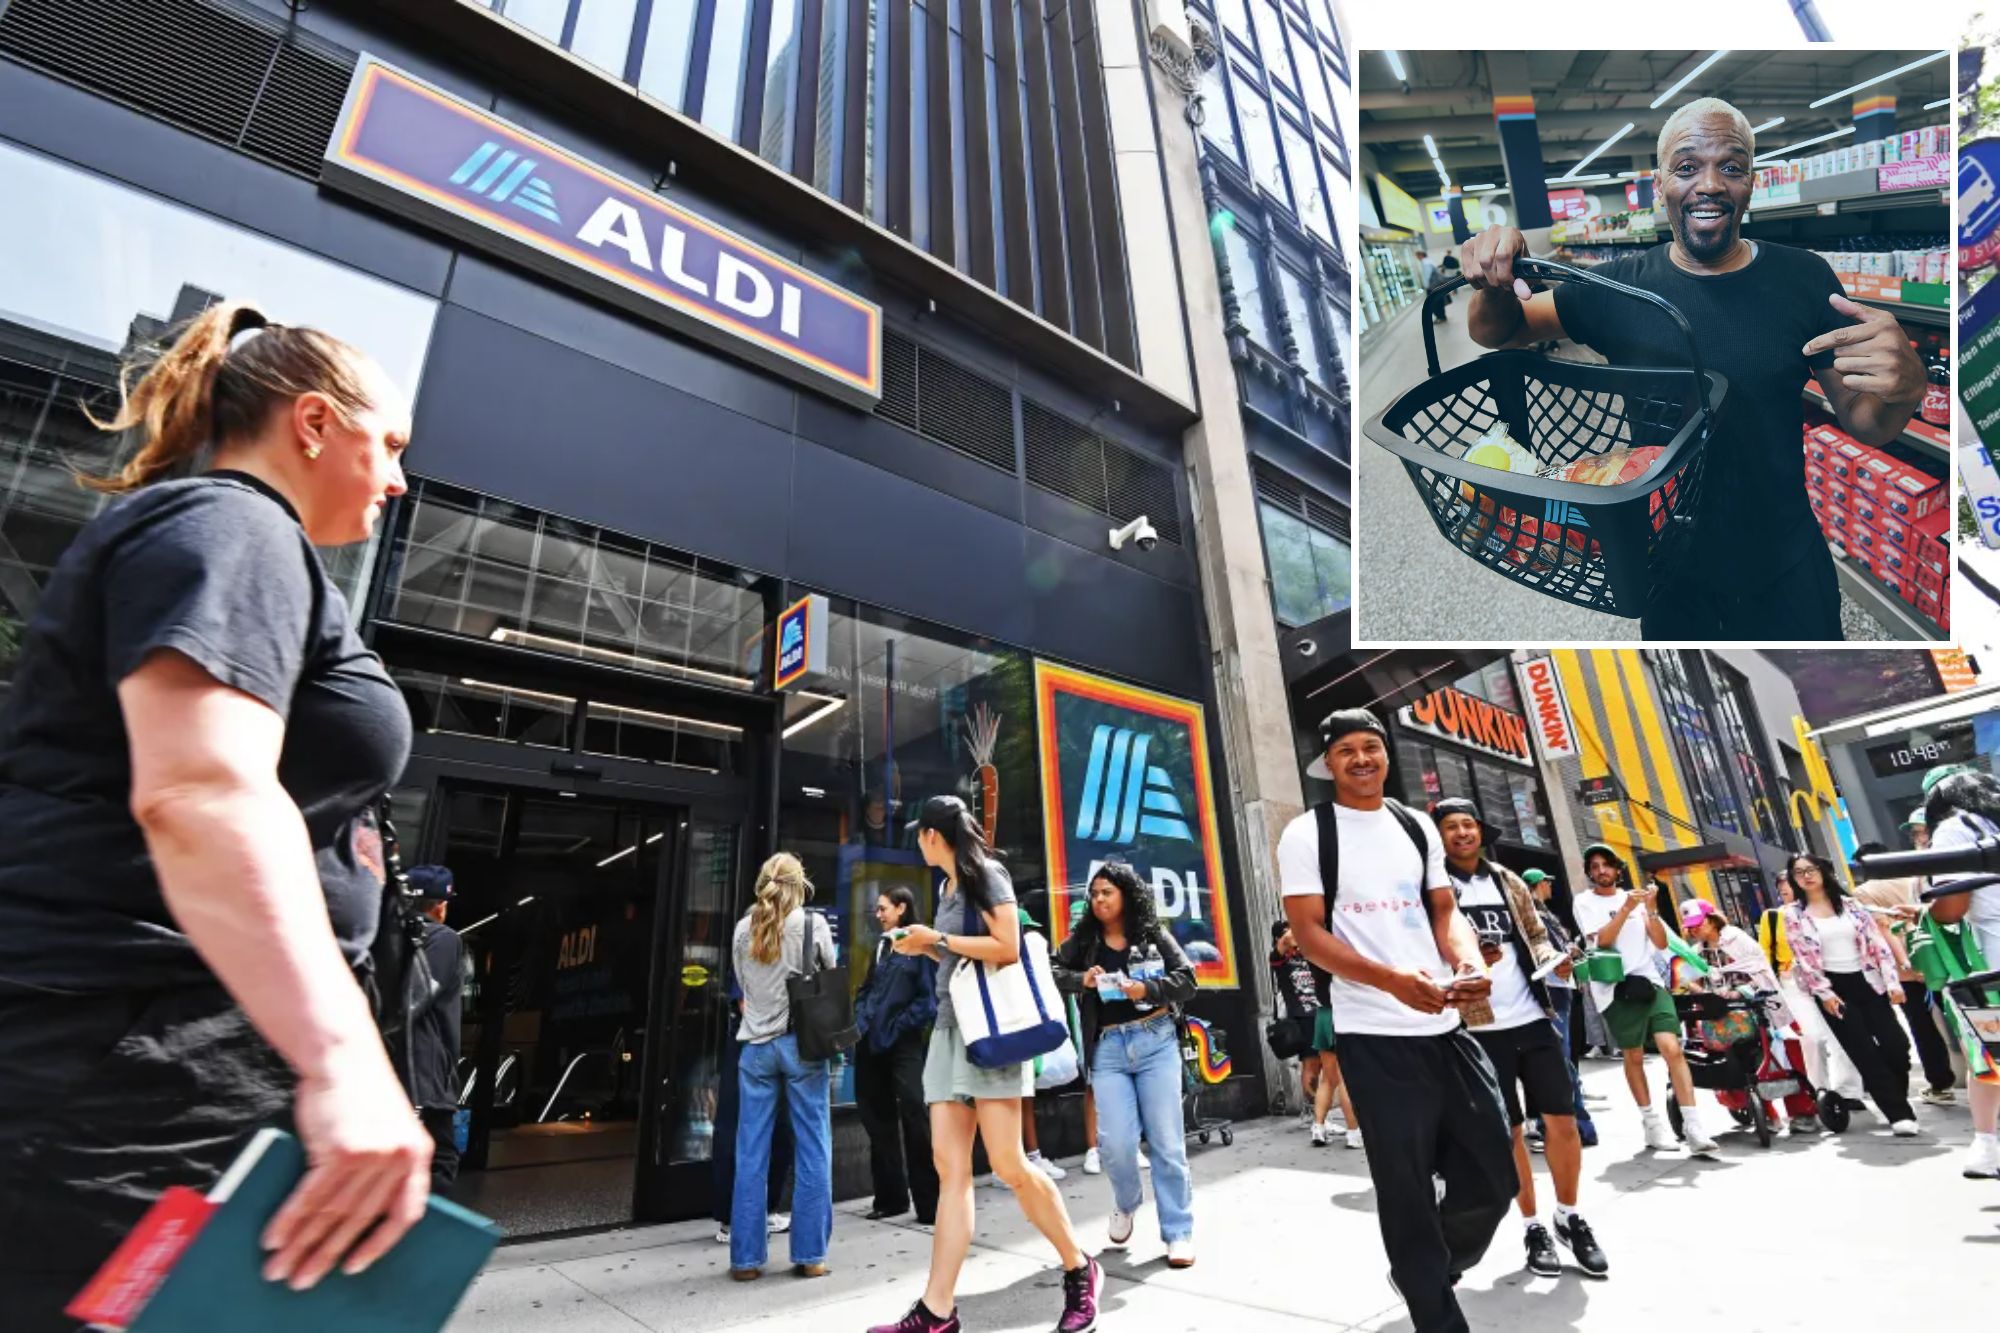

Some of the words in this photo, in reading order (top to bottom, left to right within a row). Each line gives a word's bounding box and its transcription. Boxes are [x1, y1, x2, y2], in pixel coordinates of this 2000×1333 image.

[576, 196, 801, 338] ALDI
[1978, 320, 2000, 348] Heig
[1085, 860, 1202, 919] DI
[557, 923, 598, 970] ALDI
